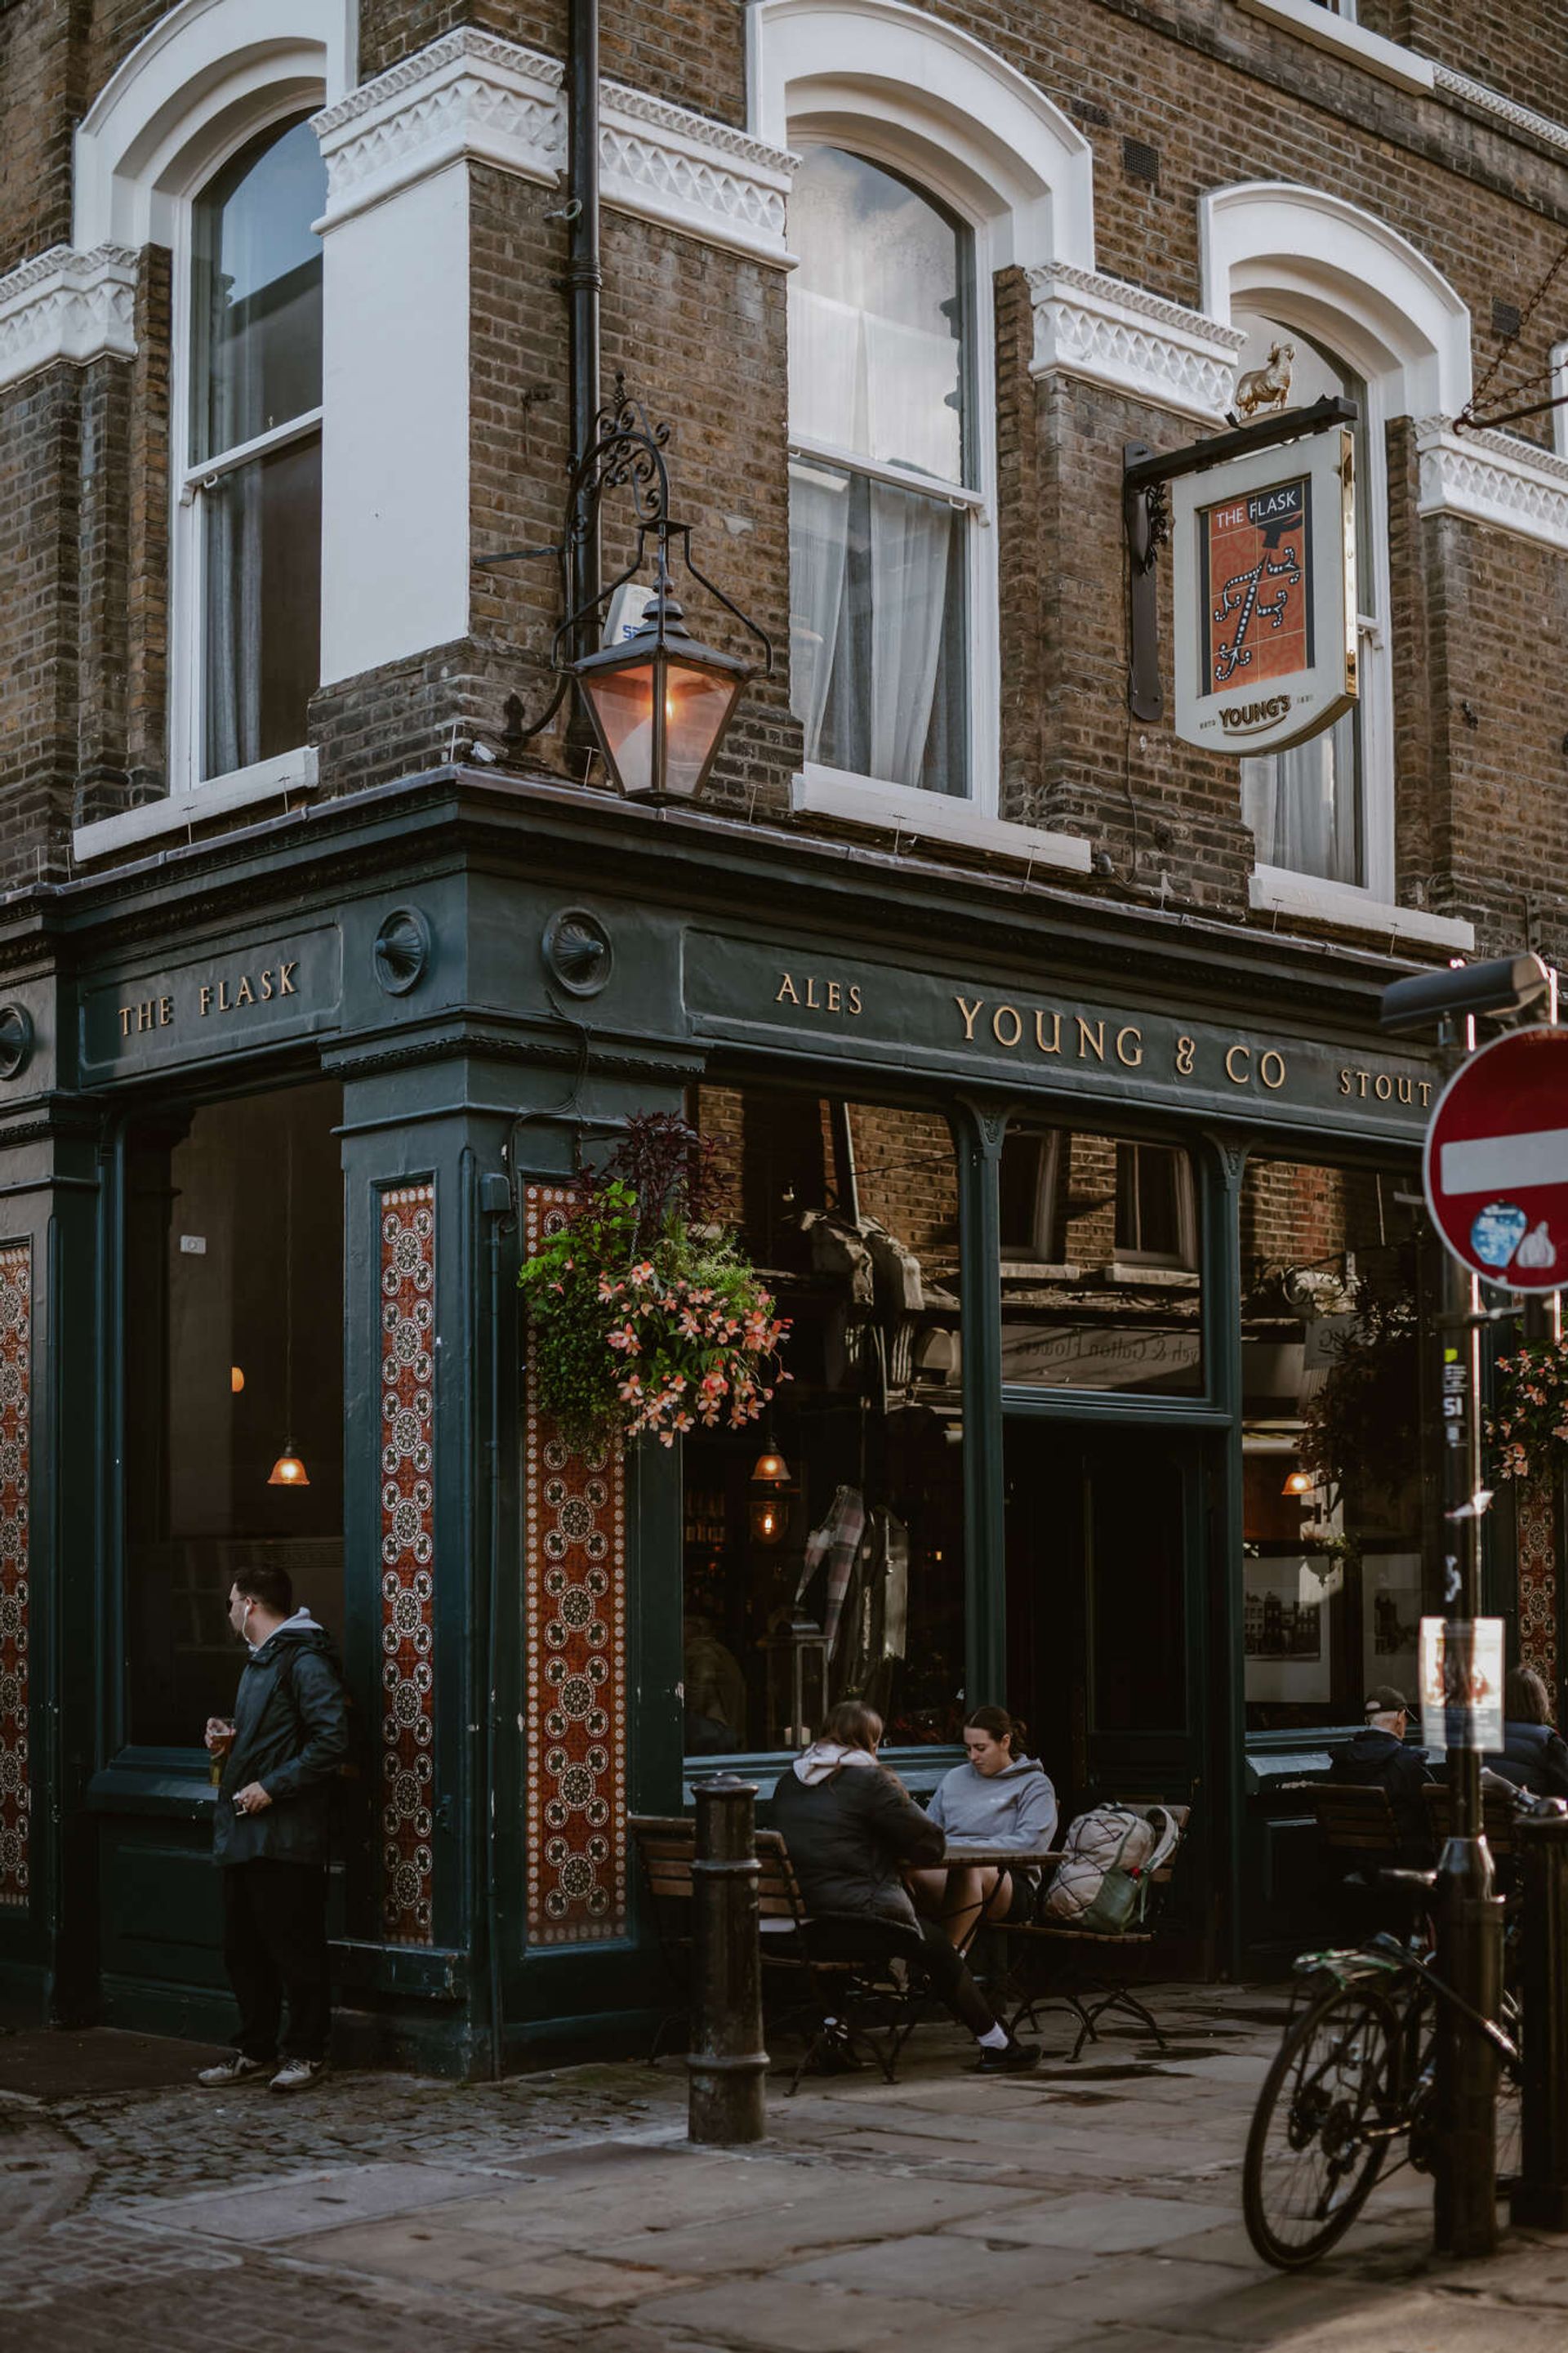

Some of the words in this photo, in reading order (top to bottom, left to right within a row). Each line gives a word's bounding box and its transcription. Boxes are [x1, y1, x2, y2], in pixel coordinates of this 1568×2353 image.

[1215, 506, 1244, 528] THE
[1250, 490, 1296, 519] FLASK
[1218, 695, 1291, 728] YOUNG'S
[118, 996, 172, 1036] THE
[199, 961, 297, 1016] FLASK
[775, 973, 863, 1015] ALES
[955, 996, 1143, 1067] YOUNG
[1176, 1035, 1196, 1076] &
[1225, 1045, 1286, 1090] CO
